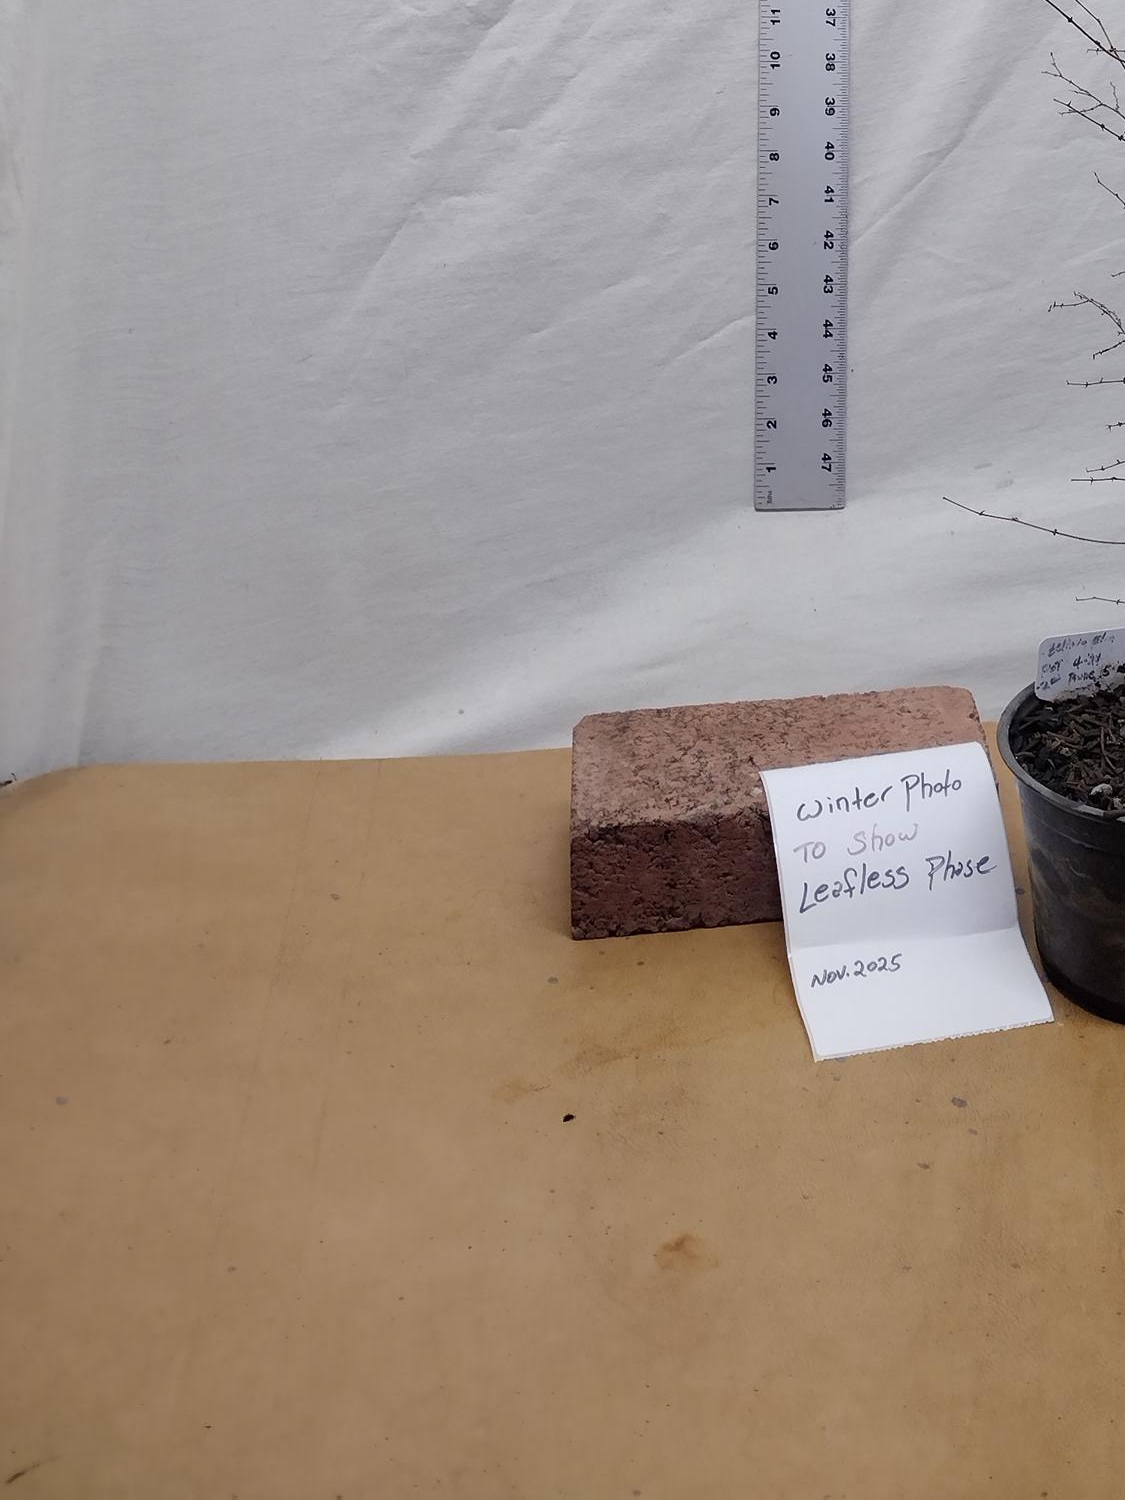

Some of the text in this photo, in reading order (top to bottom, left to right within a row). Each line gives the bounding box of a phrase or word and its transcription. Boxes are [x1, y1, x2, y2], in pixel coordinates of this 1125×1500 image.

[770, 9, 781, 26] 11
[825, 7, 837, 27] 37
[769, 51, 781, 70] 10
[825, 52, 836, 72] 38
[769, 107, 780, 117] 9
[824, 96, 836, 117] 39
[769, 152, 780, 162] 8
[824, 141, 835, 161] 40
[768, 197, 780, 206] 7
[824, 185, 835, 203] 41
[768, 241, 779, 251] 6
[823, 229, 835, 250] 42
[767, 286, 779, 296] 5
[823, 274, 834, 294] 43
[767, 330, 778, 340] 4
[822, 319, 834, 339] 44
[766, 375, 778, 385] 3
[822, 363, 833, 384] 45
[766, 420, 777, 430] 2
[821, 407, 833, 428] 46
[821, 452, 832, 473] 47
[900, 768, 962, 812] Photo
[799, 849, 998, 914] Leafless Phase
